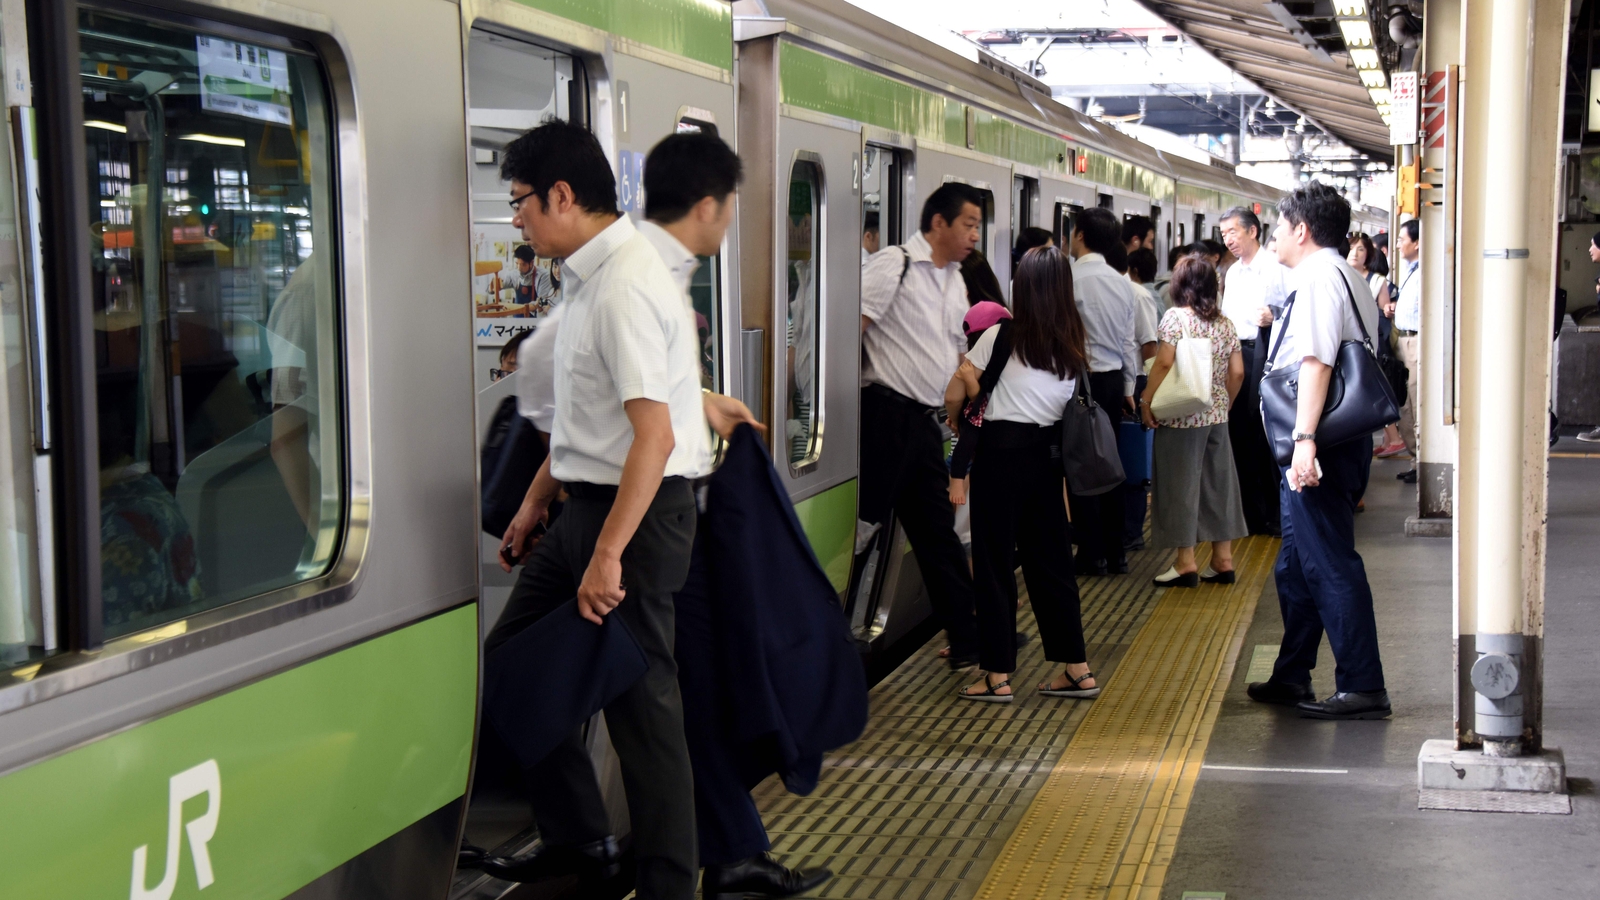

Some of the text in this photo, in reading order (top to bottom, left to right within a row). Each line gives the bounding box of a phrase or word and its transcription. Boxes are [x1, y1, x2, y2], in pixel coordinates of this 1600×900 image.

[620, 91, 627, 132] 1
[853, 159, 858, 189] 2
[129, 758, 221, 900] JR
